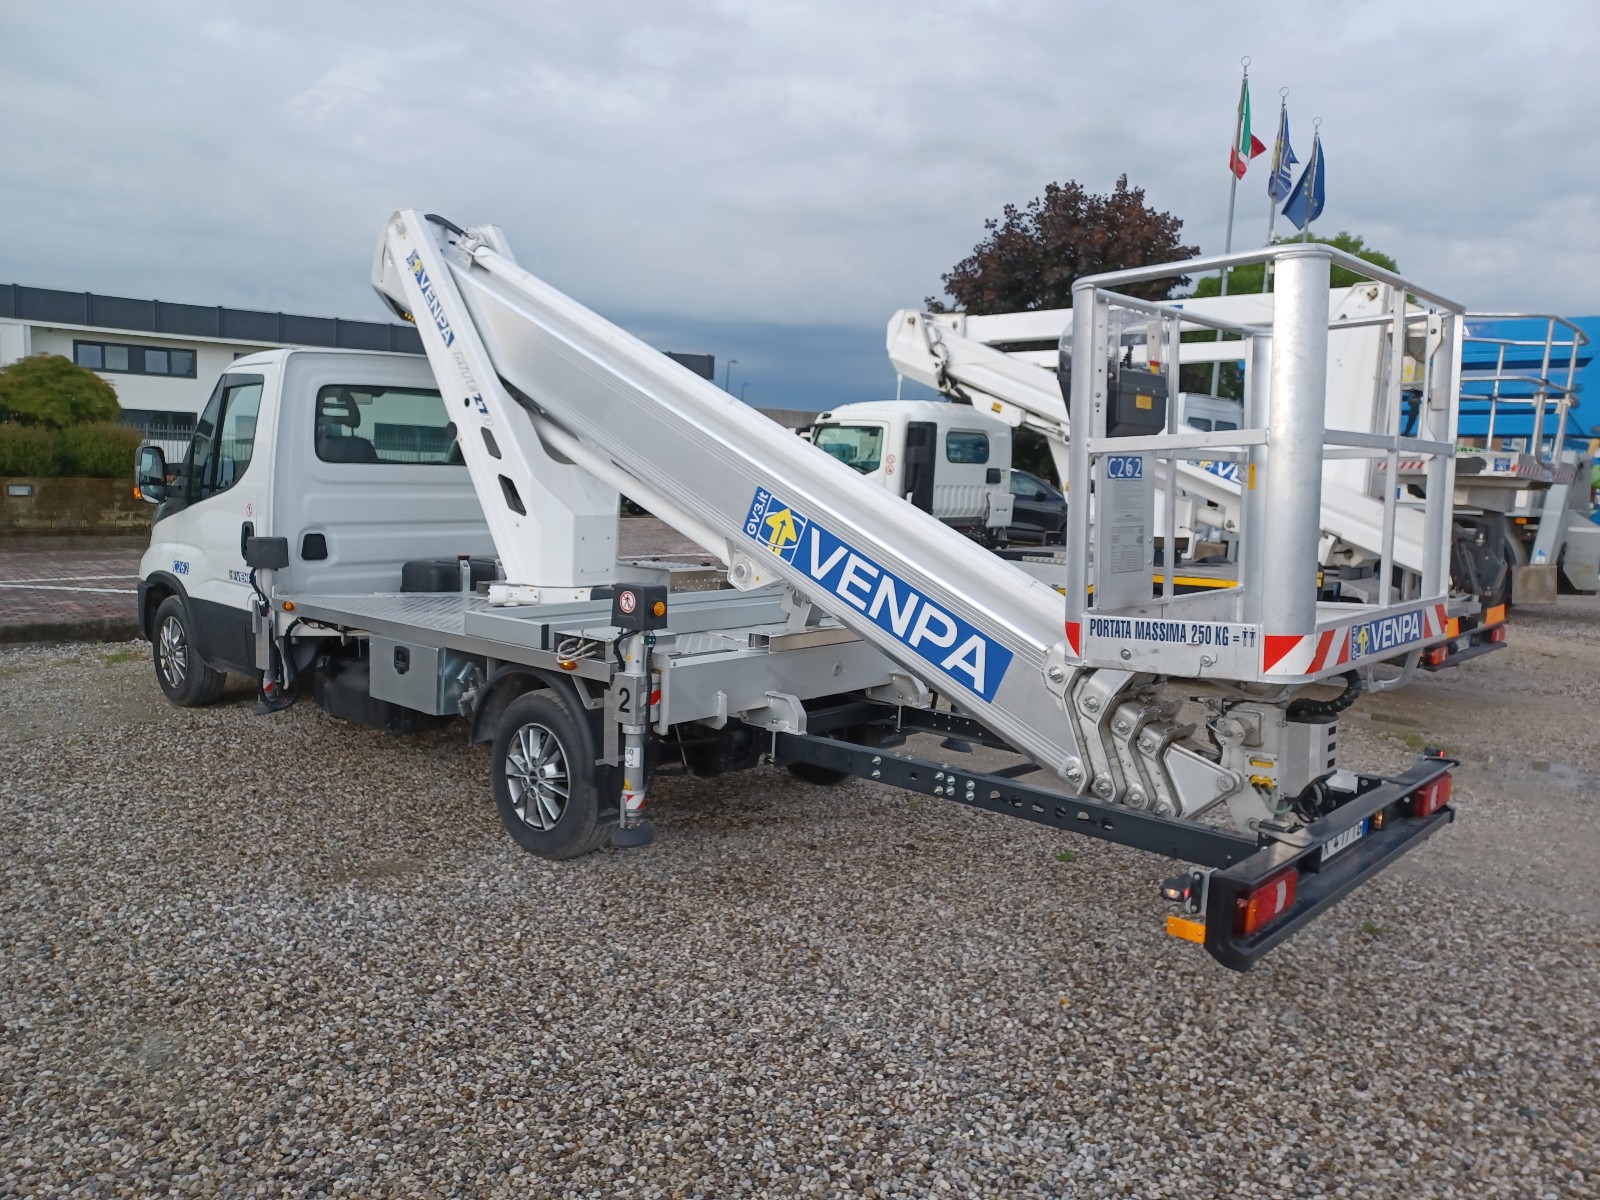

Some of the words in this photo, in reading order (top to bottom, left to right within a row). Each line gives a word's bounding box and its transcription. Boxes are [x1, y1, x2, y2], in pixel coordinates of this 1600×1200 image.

[419, 271, 452, 345] VENPA
[1107, 457, 1142, 478] C262
[810, 526, 987, 695] VENPA
[1089, 618, 1131, 639] PORTATA
[1135, 621, 1187, 643] MASSIMA
[1191, 624, 1212, 645] 250
[1215, 625, 1229, 646] KG
[1371, 612, 1420, 651] VENPA
[618, 687, 631, 714] 2
